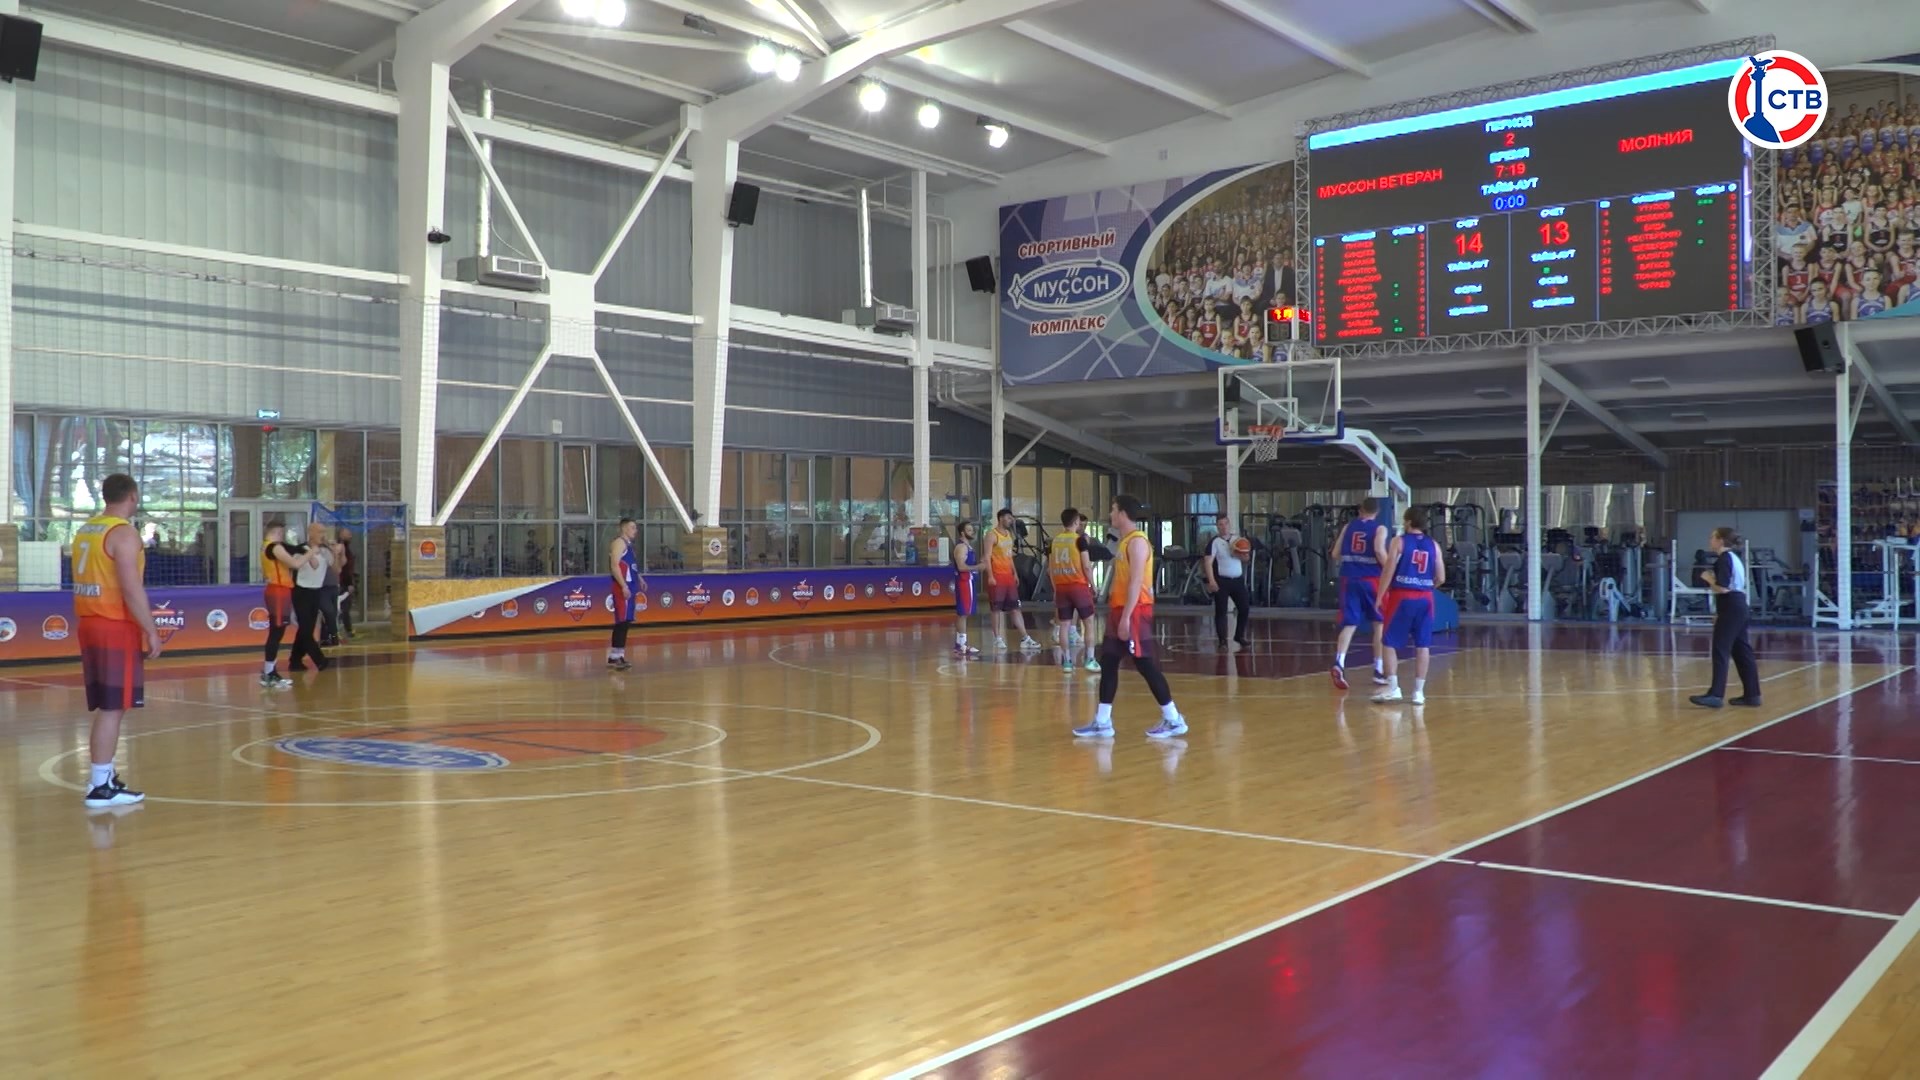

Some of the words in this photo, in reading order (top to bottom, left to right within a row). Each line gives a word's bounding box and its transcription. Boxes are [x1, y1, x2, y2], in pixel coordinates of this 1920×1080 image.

[1505, 132, 1516, 146] 2
[1620, 128, 1693, 152] МОЛНИЯ
[1496, 162, 1526, 178] 7:19
[1319, 179, 1376, 199] МУССОН
[1378, 168, 1443, 190] ВЕТЕРАН
[1494, 194, 1526, 211] 0:00
[1019, 228, 1115, 258] СПОРТИВНЫЙ
[1455, 231, 1484, 256] 14
[1538, 221, 1570, 245] 13
[1034, 274, 1109, 298] МУССОН
[1030, 315, 1106, 335] КОМПЛЕКС
[1351, 531, 1366, 553] 6
[77, 541, 90, 575] 7
[1055, 547, 1070, 564] 14
[1411, 549, 1429, 574] 4
